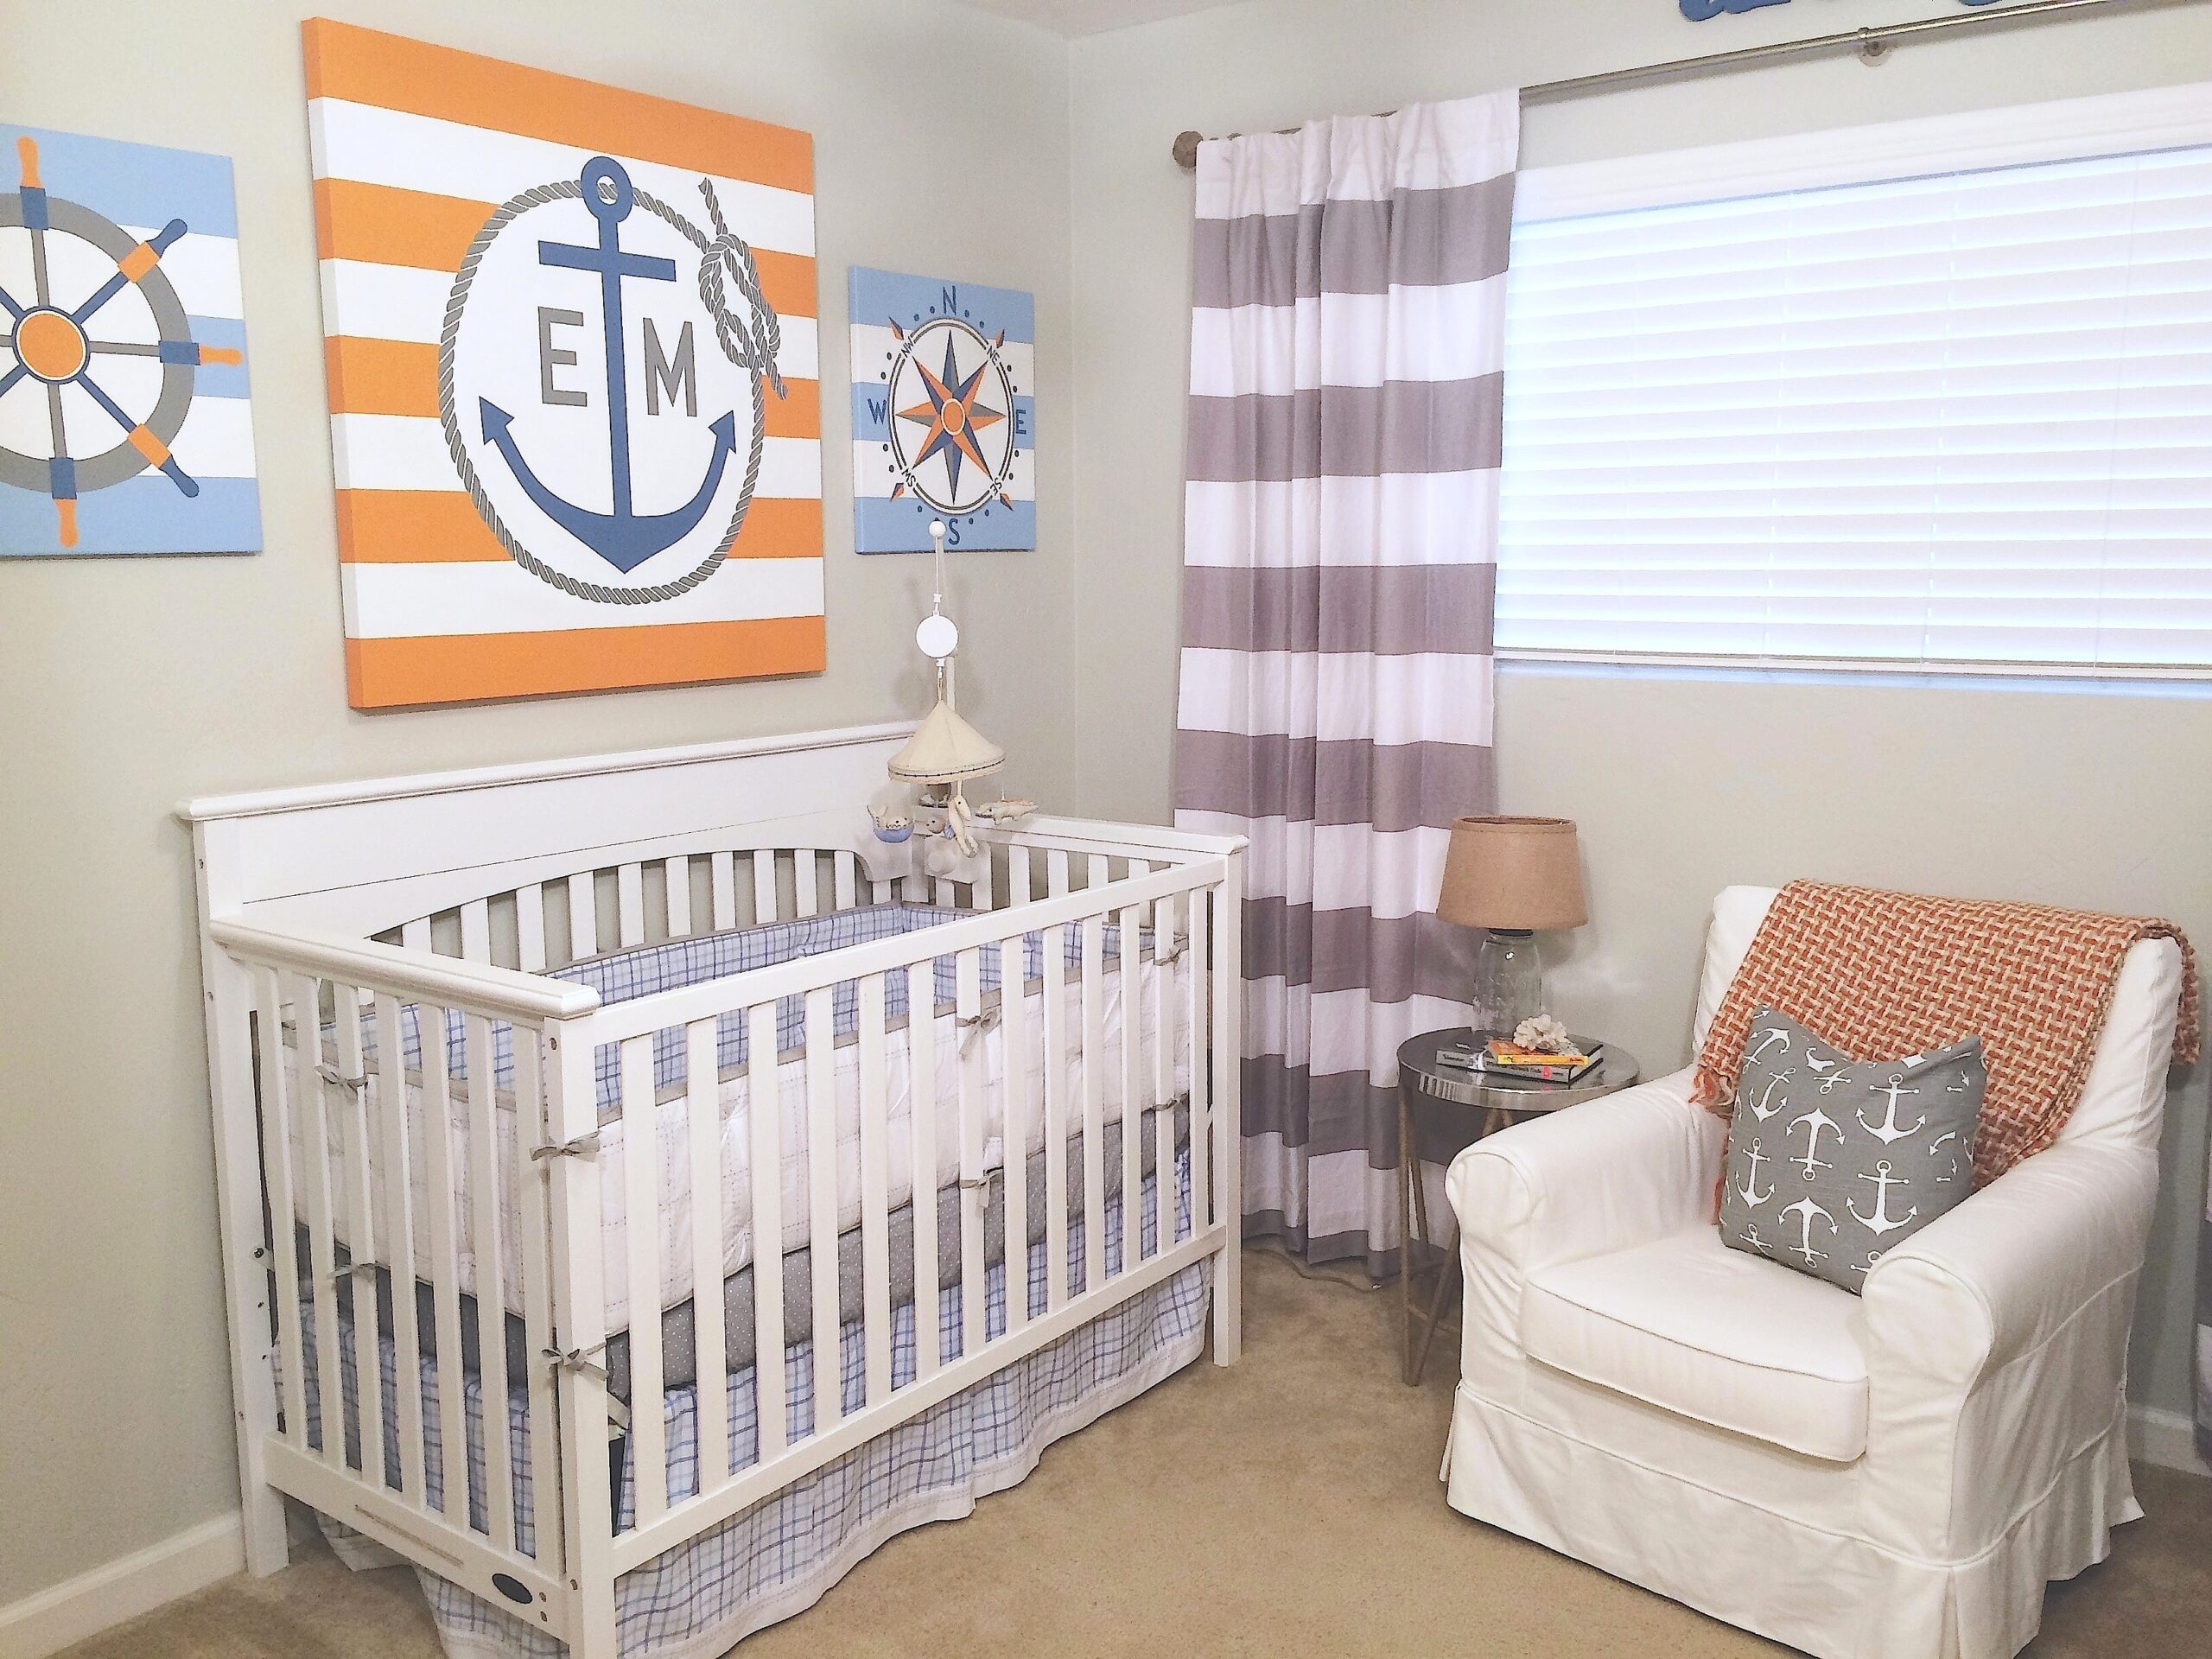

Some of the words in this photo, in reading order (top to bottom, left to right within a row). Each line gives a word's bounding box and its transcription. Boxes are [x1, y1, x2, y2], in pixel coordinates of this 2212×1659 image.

[943, 285, 957, 315] N
[900, 335, 914, 358] NW
[987, 345, 1000, 365] NE
[537, 306, 588, 407] E
[643, 317, 697, 417] M
[868, 398, 887, 424] W
[1015, 410, 1027, 435] E
[990, 477, 1002, 496] SE
[949, 518, 960, 545] S
